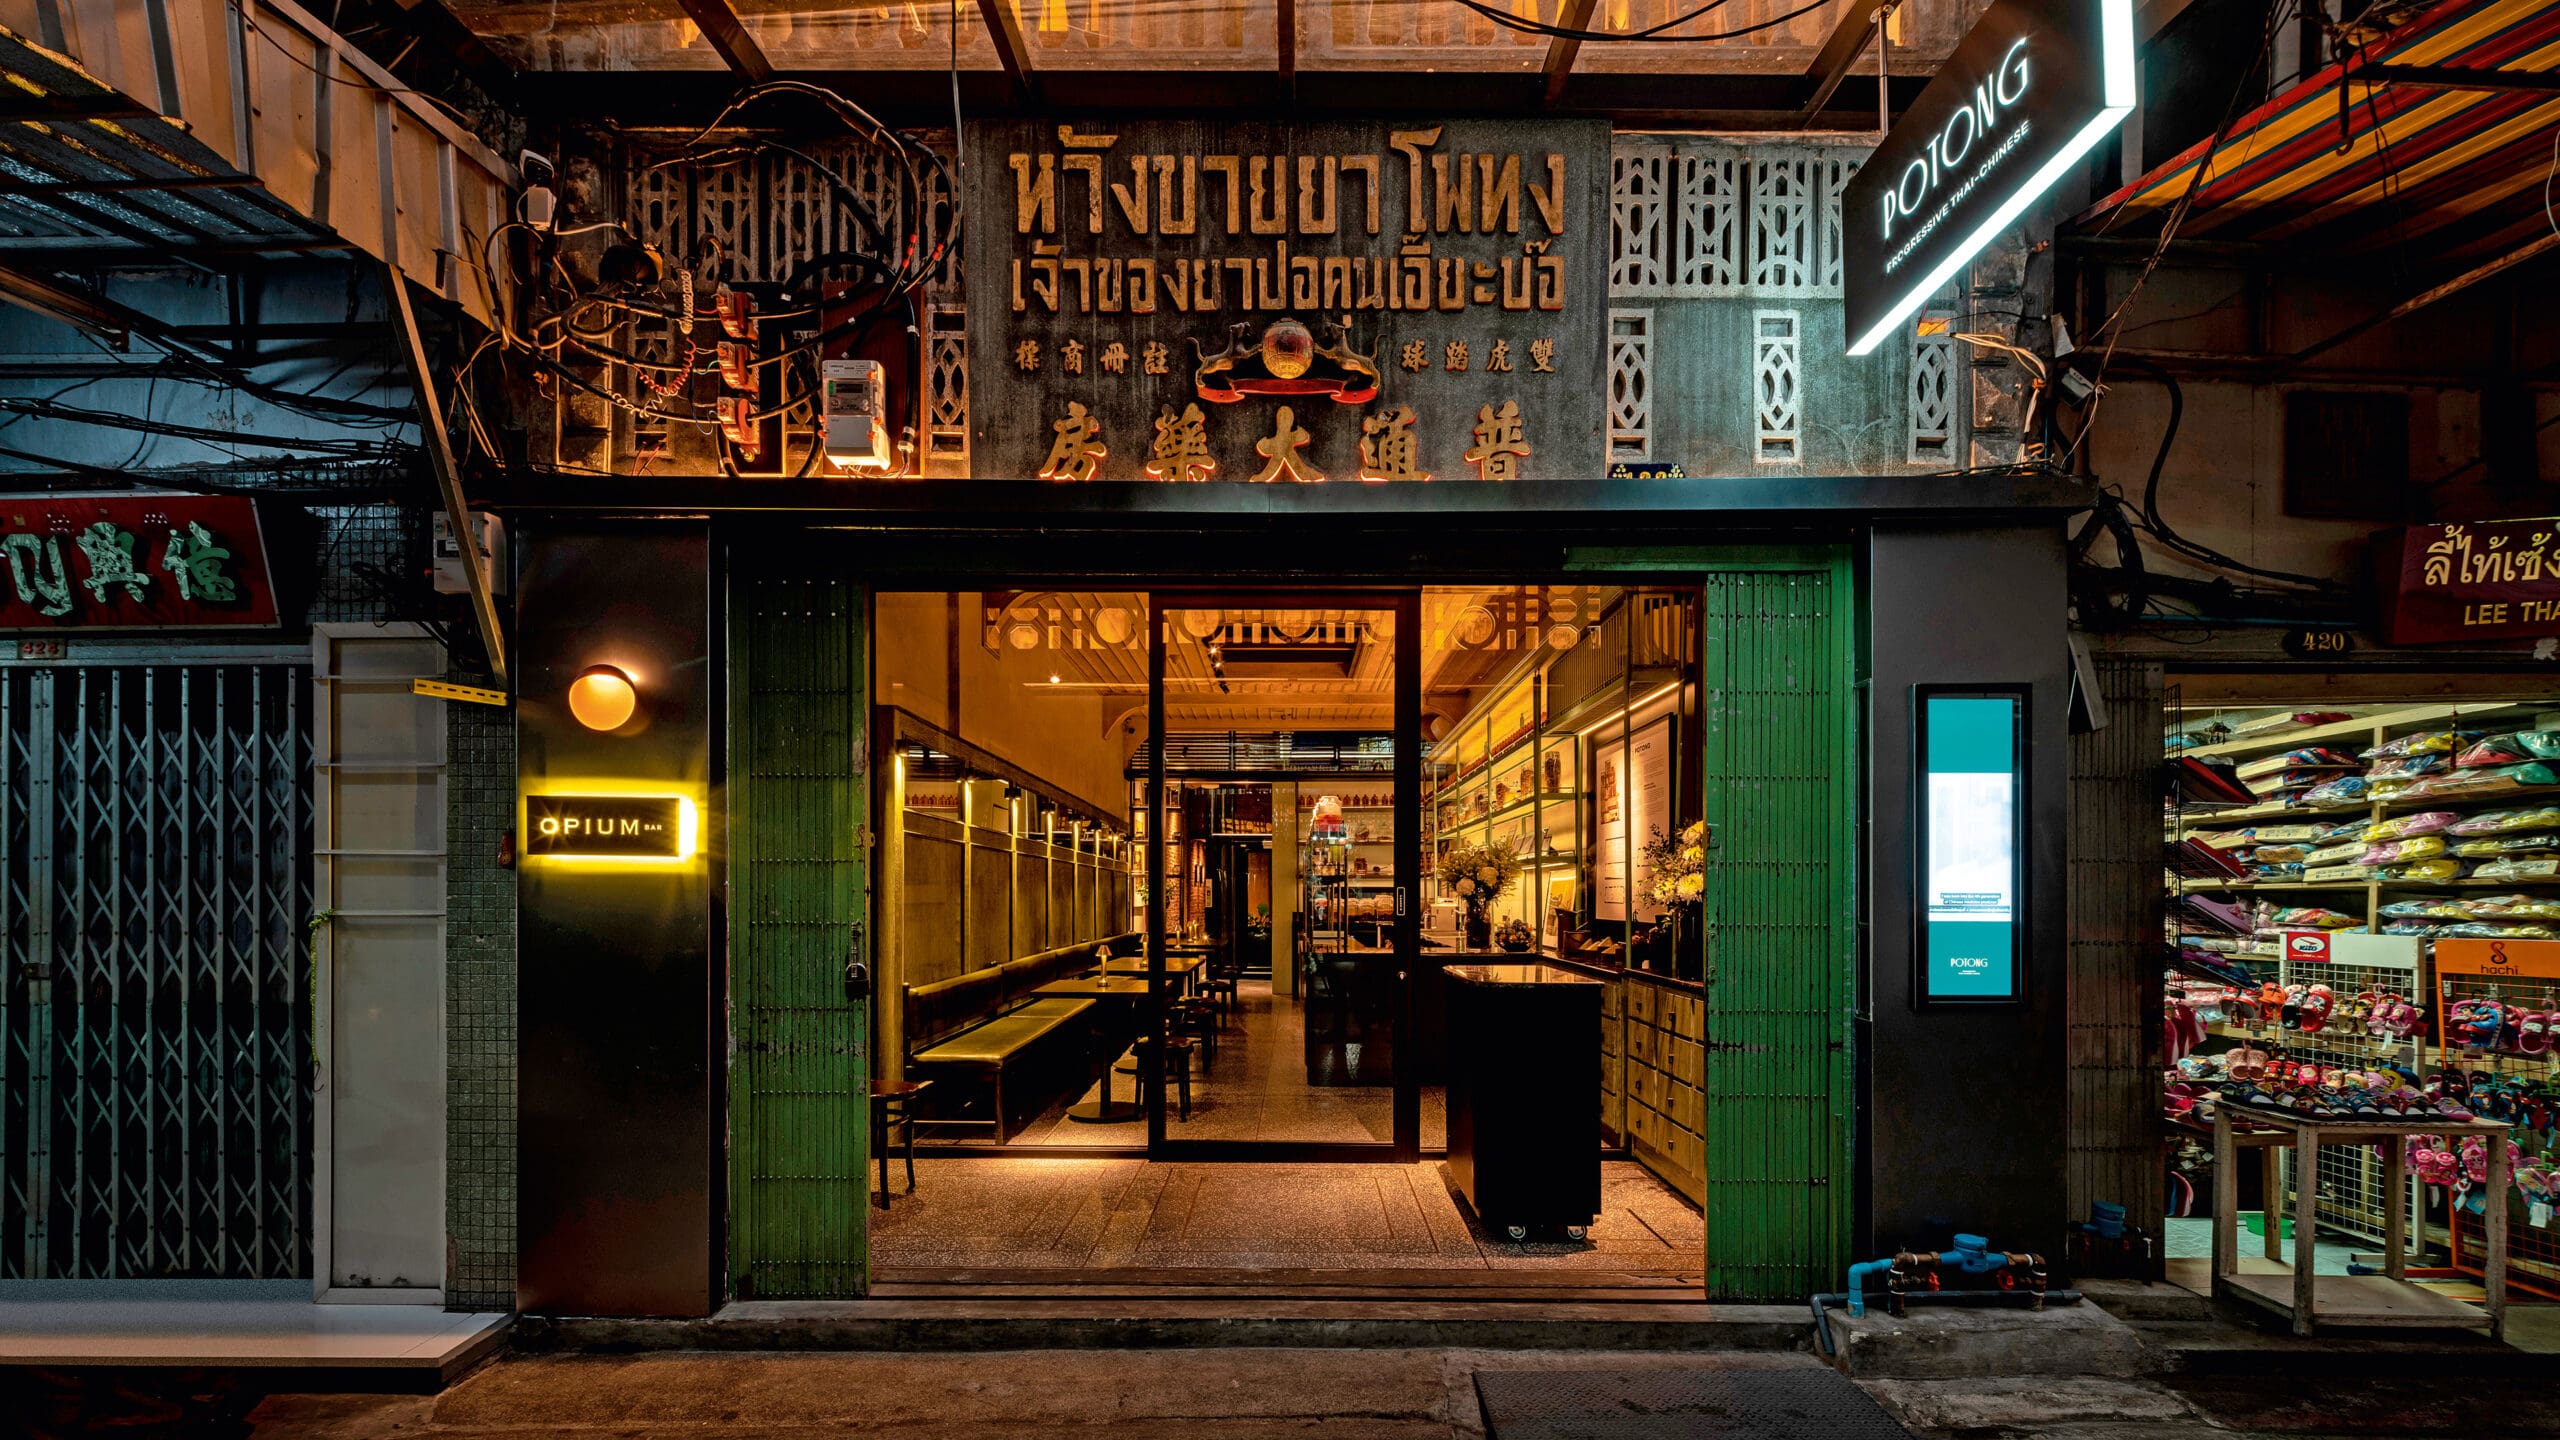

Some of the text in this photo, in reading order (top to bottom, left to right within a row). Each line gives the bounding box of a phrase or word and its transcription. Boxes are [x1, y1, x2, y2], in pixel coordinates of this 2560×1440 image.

[1883, 36, 2030, 240] POTONG
[1886, 119, 2031, 273] PROGRESSIVE THAI-CHINESE
[2464, 603, 2508, 625] LEE
[2302, 631, 2345, 652] 420
[540, 818, 663, 836] OPIUM BAR
[1950, 957, 1988, 968] POTONG
[2480, 964, 2521, 975] hachi
